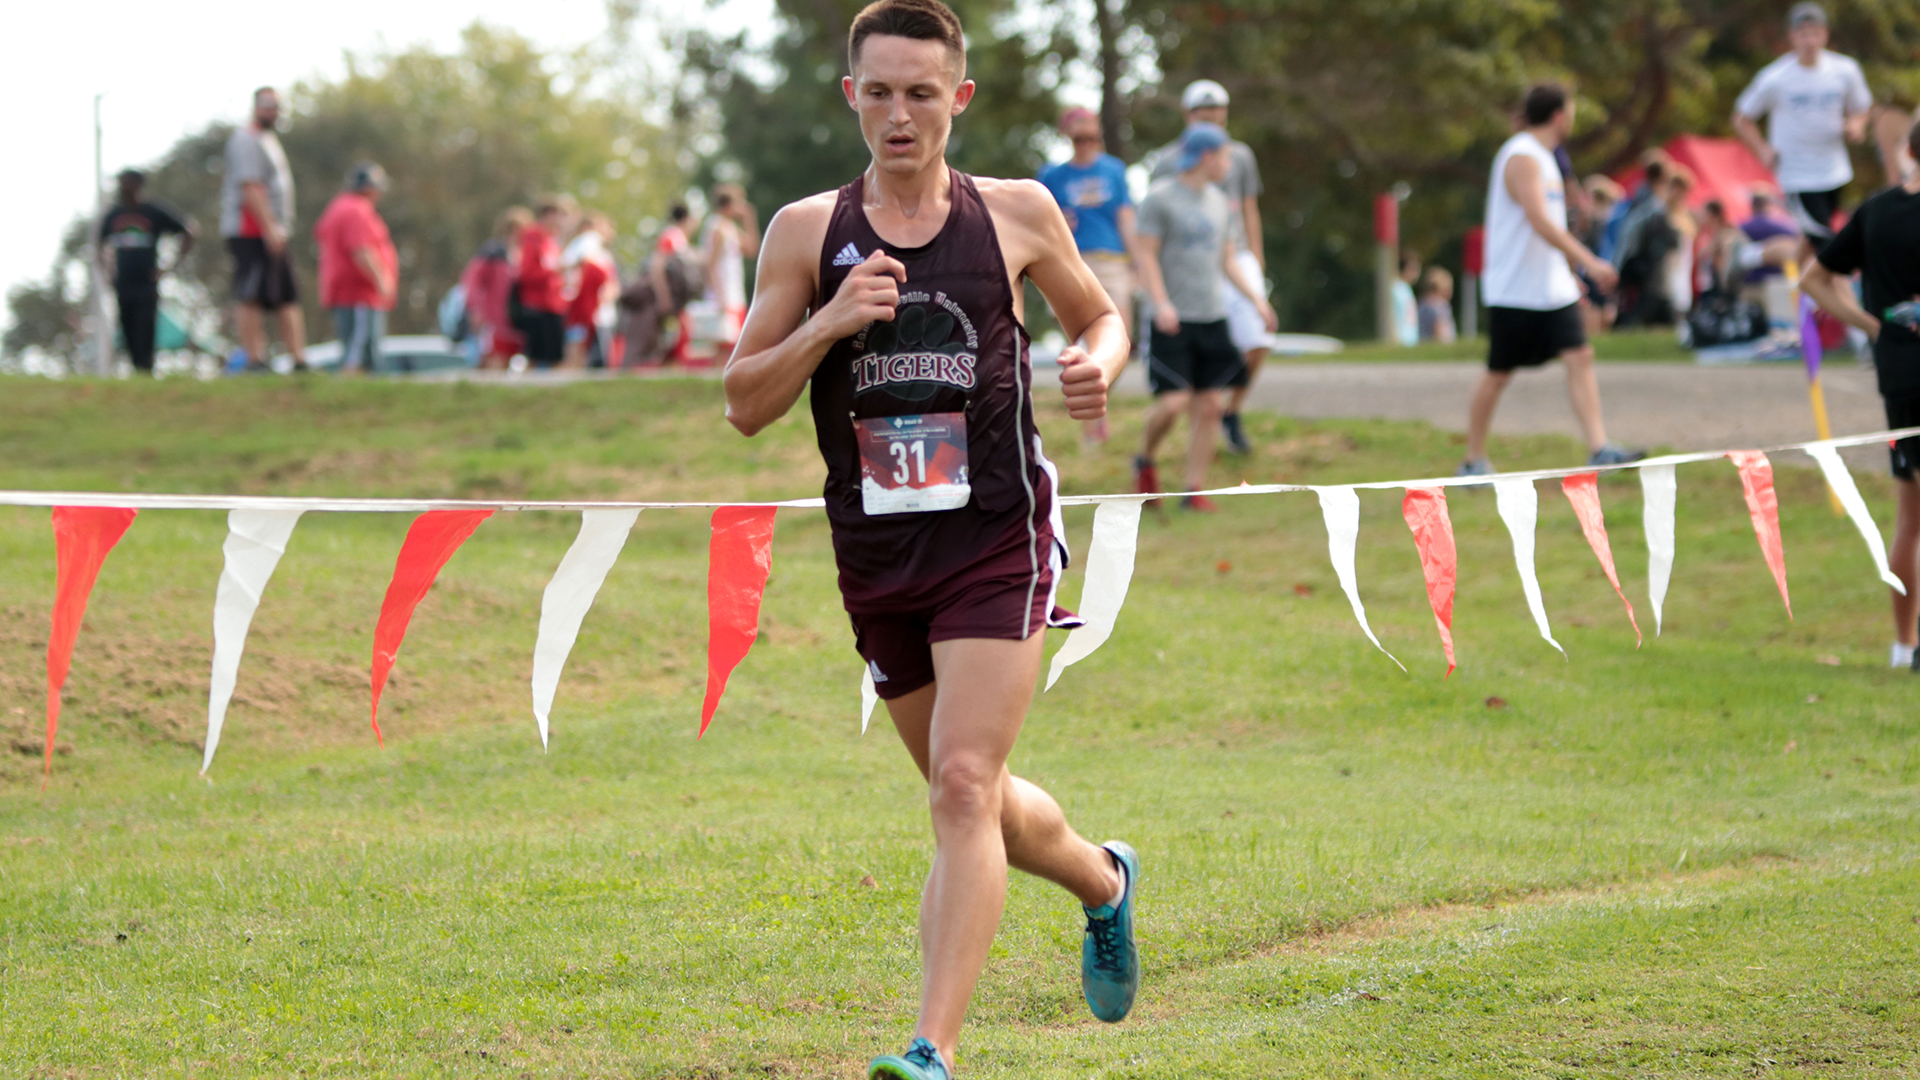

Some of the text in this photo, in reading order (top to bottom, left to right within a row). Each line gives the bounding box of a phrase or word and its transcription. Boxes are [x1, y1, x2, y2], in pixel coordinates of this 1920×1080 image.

[832, 256, 864, 266] adidas
[852, 352, 977, 392] TIGERS
[889, 440, 926, 485] 31
